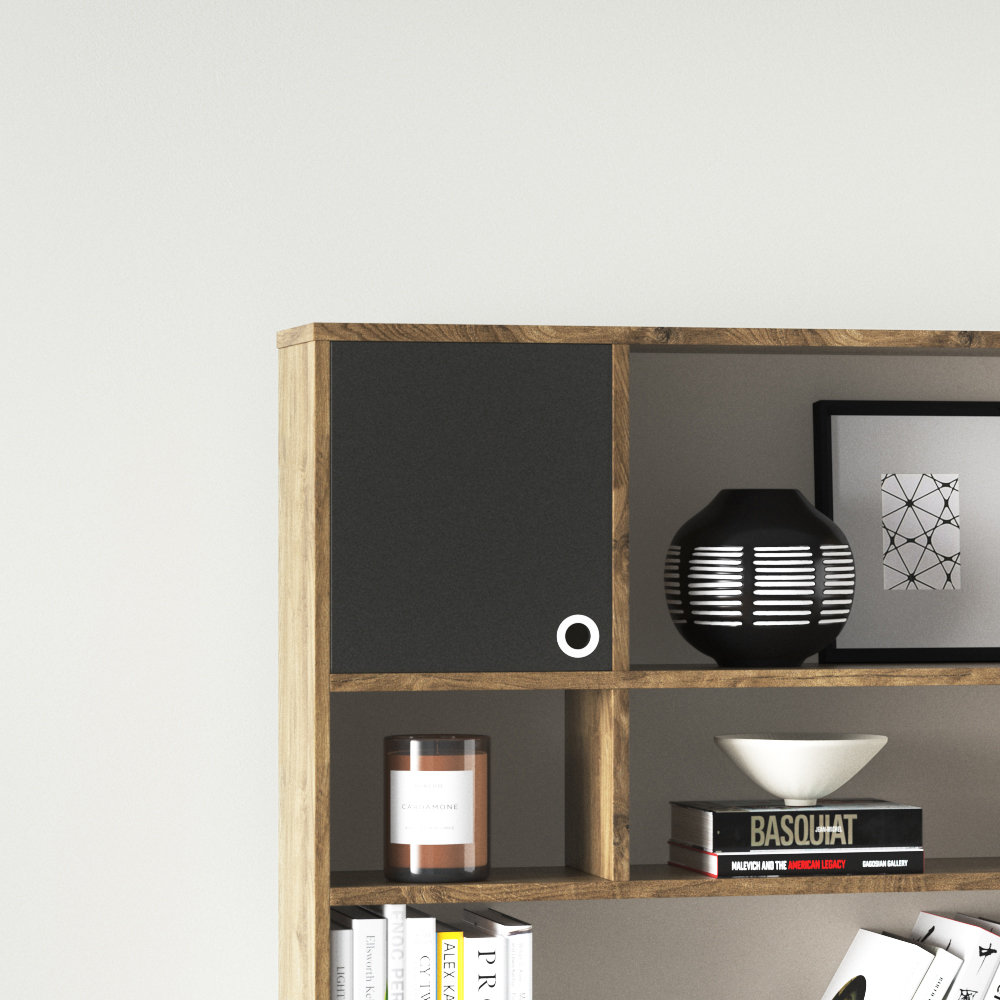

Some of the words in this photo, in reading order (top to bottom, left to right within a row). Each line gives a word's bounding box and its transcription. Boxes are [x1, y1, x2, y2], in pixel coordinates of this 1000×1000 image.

[751, 814, 858, 847] BASQUIAT
[731, 860, 761, 871] MALEVICH
[761, 860, 775, 870] AND
[775, 860, 788, 870] THE
[788, 859, 820, 870] AMERICAN
[821, 859, 846, 870] LEGACY
[862, 860, 887, 868] GAGOSIAN
[886, 859, 908, 867] GALLERY
[391, 910, 405, 960] ENOC
[365, 935, 376, 982] Ellsworth
[419, 955, 431, 976] CY
[443, 942, 456, 978] ALEX
[336, 966, 346, 1000] LIGHT
